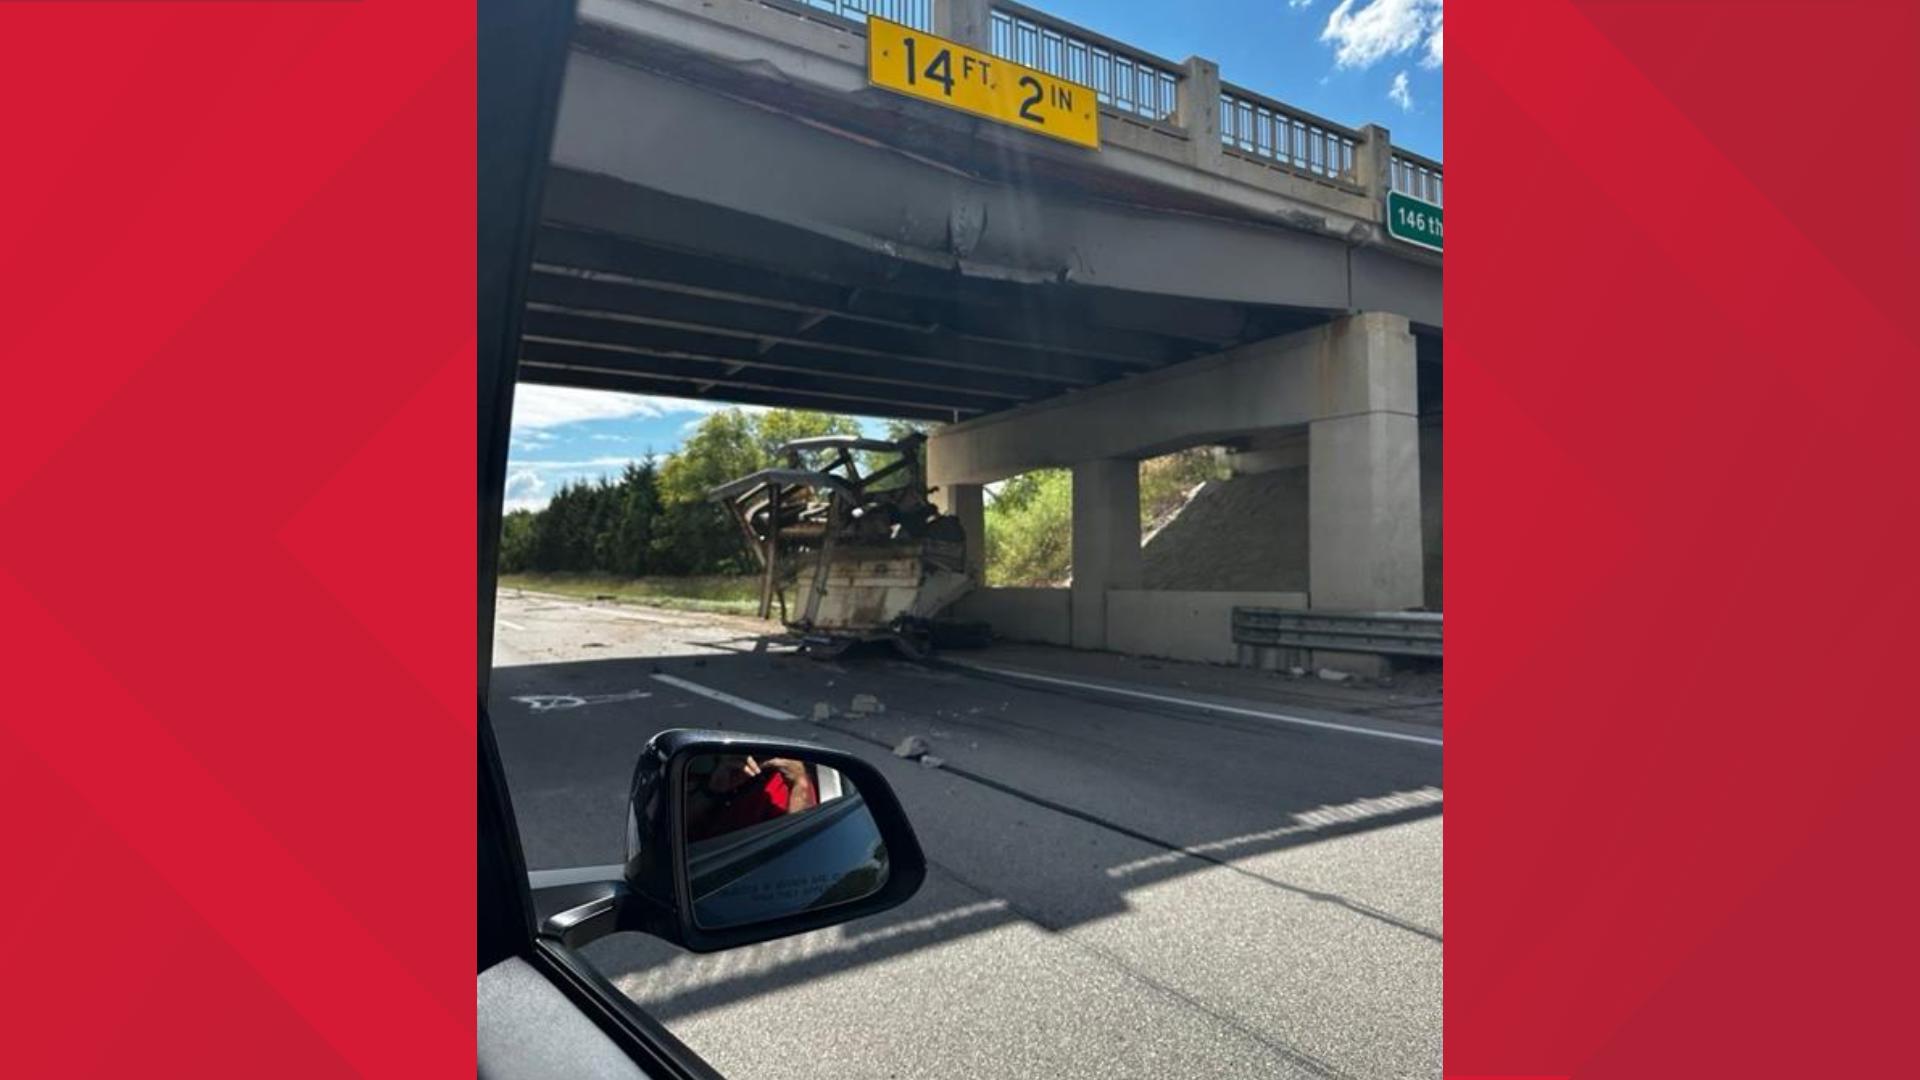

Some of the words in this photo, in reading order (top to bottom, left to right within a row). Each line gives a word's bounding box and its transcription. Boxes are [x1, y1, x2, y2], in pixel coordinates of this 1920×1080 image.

[903, 37, 955, 97] 14
[1019, 76, 1044, 124] 2
[1051, 85, 1073, 112] IN
[1398, 207, 1425, 231] 146
